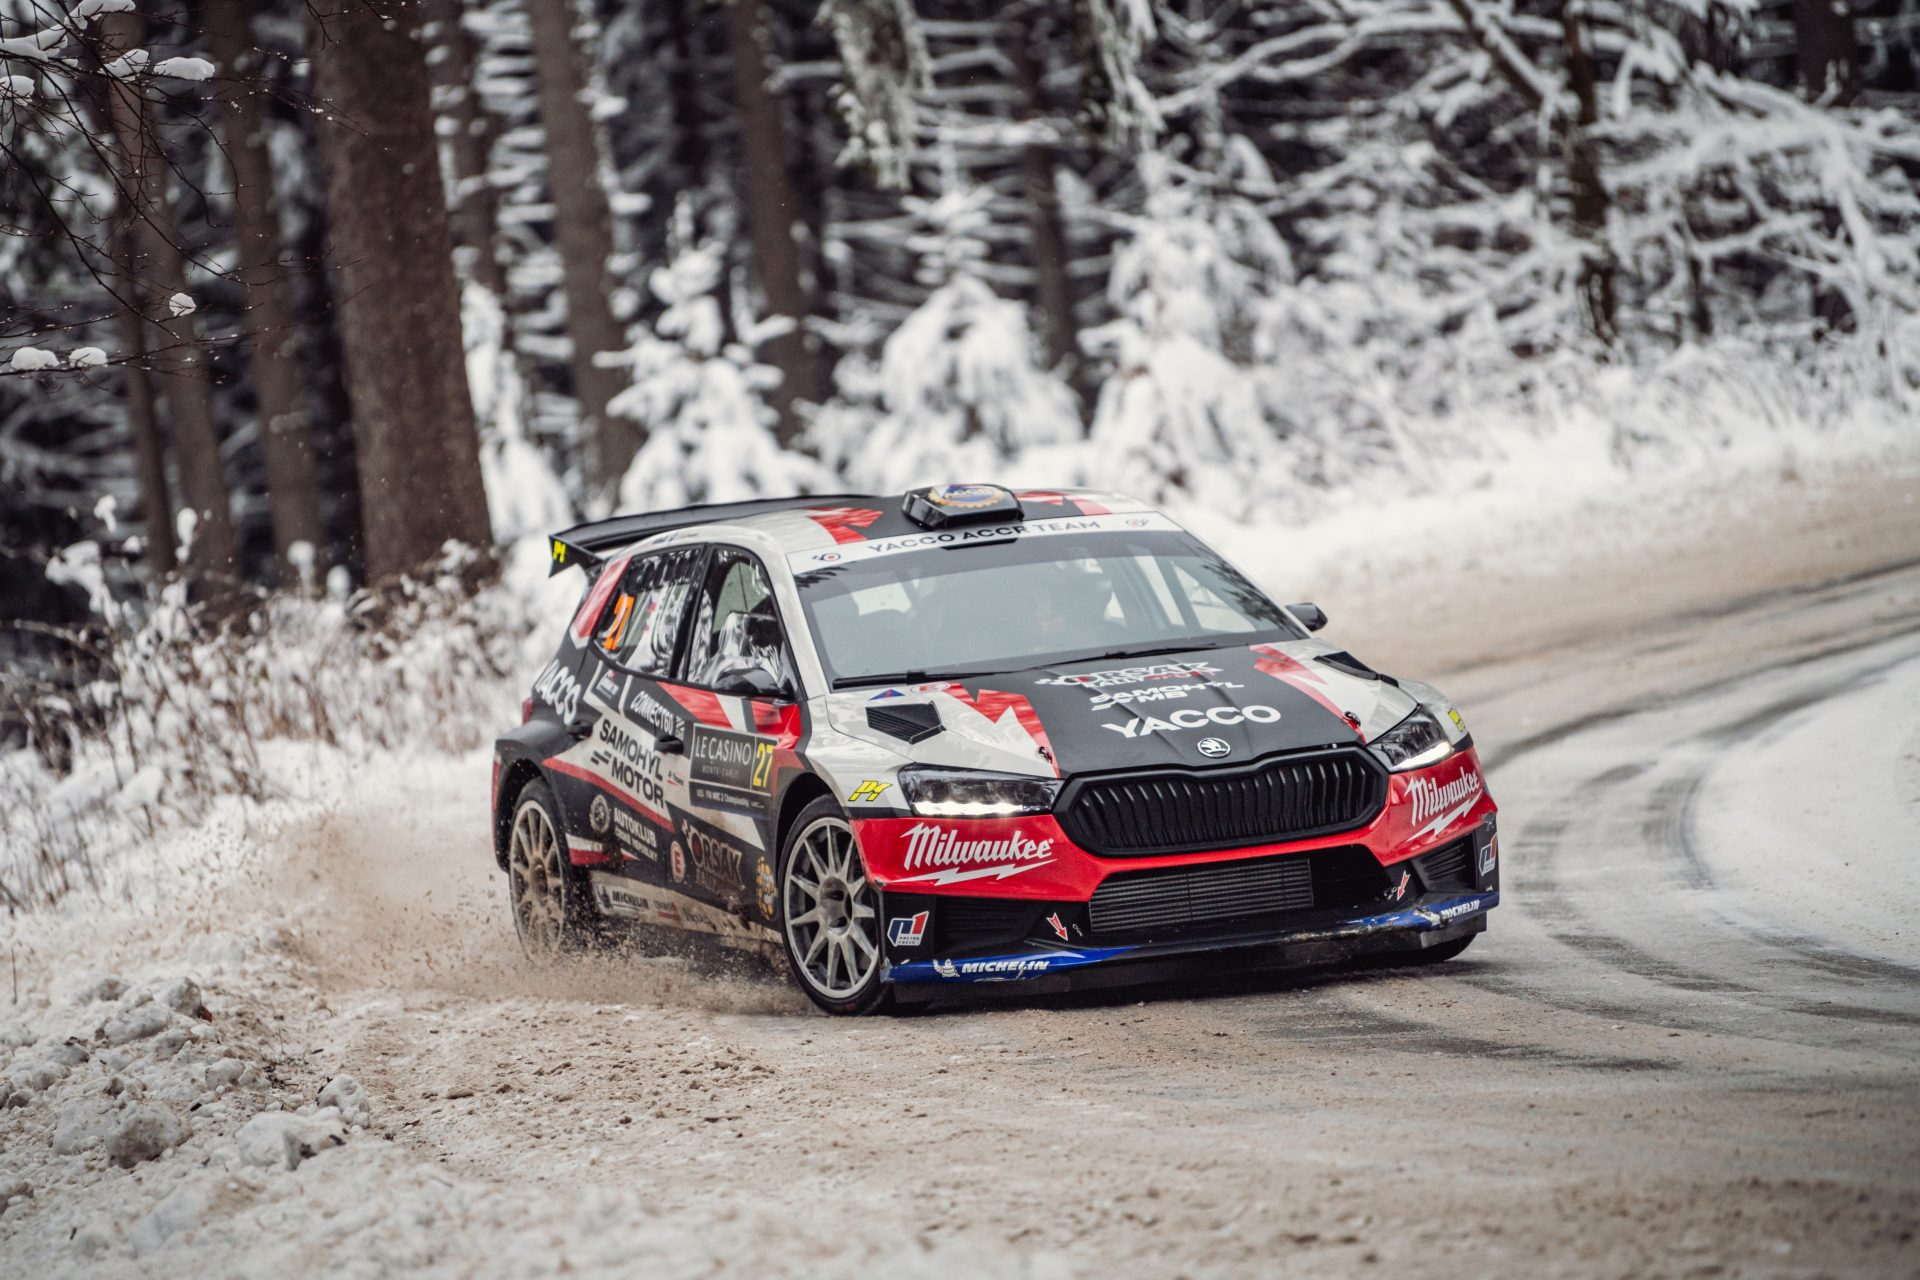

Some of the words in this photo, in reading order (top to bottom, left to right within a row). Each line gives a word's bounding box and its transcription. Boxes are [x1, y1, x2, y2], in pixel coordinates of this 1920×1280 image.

[867, 534, 955, 553] YACCO
[962, 525, 1027, 540] ACCR
[1034, 521, 1101, 534] TEAM
[1090, 681, 1245, 705] SAMOHYL
[630, 690, 674, 735] CONNECT60
[1101, 705, 1282, 738] YACCO
[600, 719, 663, 781] SAMOHYL
[695, 736, 708, 758] LE
[708, 738, 752, 765] CASINO
[753, 743, 774, 787] 27
[611, 757, 665, 809] MOTOR
[848, 780, 893, 801] P1
[1404, 766, 1480, 827] Milwaukee
[614, 807, 657, 848] AUTOKLUB
[900, 822, 1053, 870] Milwaukee
[674, 851, 682, 873] E
[1440, 899, 1480, 919] MICHELIN
[961, 960, 1050, 974] MICHELIN
